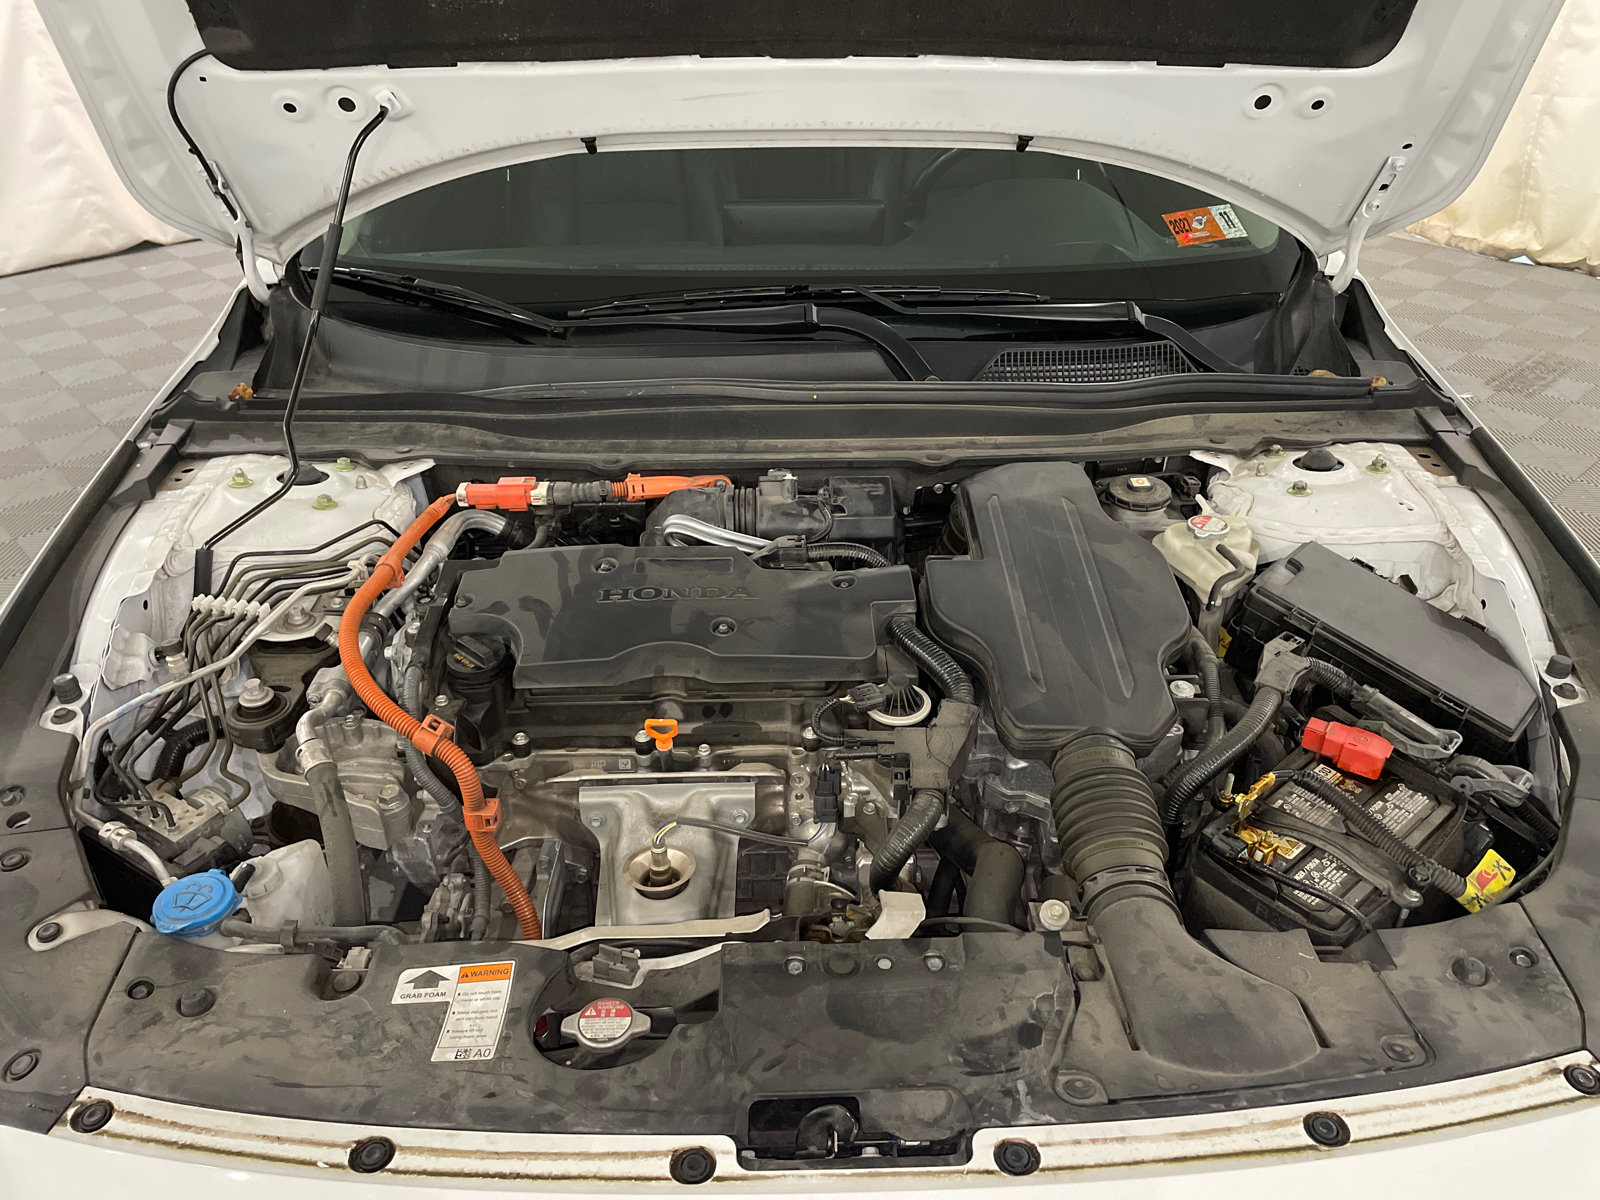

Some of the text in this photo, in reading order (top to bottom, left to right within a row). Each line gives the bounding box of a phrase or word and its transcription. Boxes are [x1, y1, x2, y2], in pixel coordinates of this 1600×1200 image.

[1218, 211, 1236, 229] 11
[597, 586, 760, 603] HONDA
[470, 968, 510, 978] WARNING
[400, 992, 422, 1000] GRAB
[472, 1048, 491, 1058] A0
